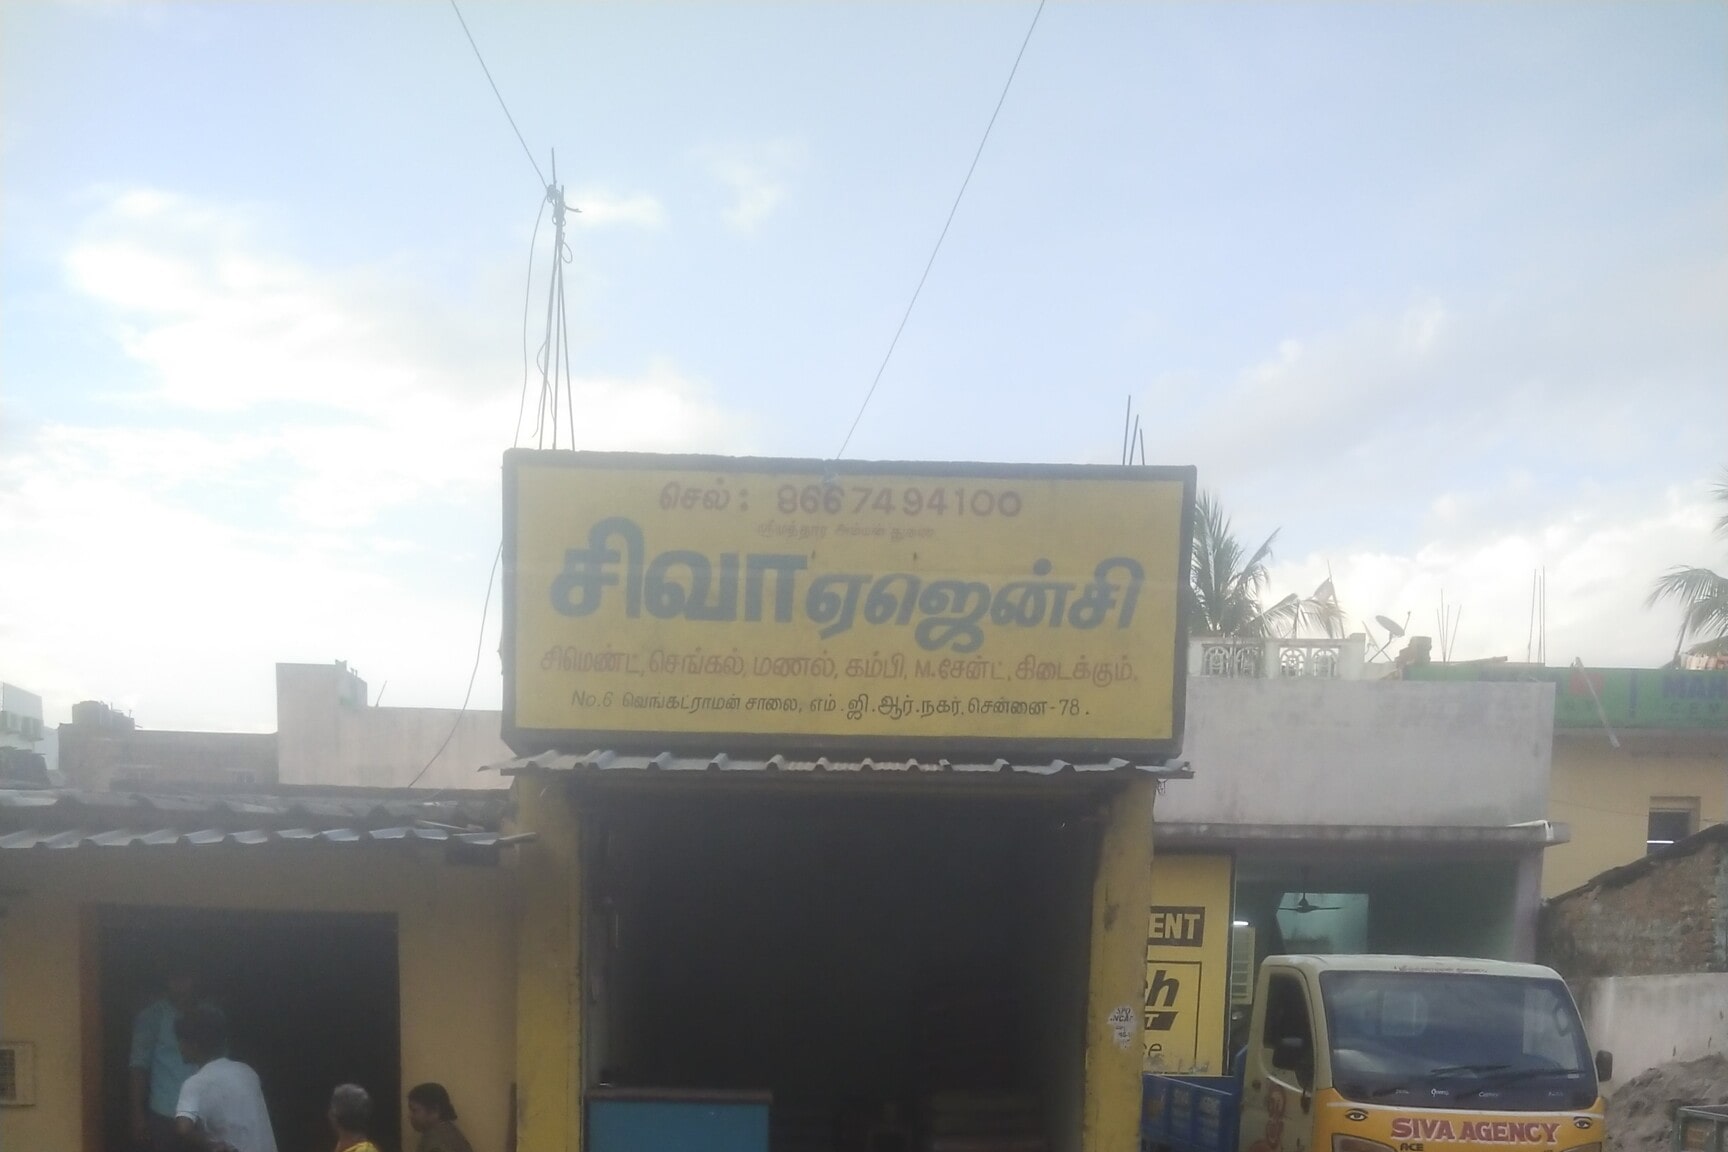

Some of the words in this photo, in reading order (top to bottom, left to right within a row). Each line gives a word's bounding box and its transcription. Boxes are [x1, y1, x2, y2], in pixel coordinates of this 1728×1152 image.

[550, 516, 808, 623] சிவா
[805, 556, 1145, 653] ஏஜென்சி
[1391, 1117, 1456, 1141] SIVA
[1459, 1120, 1561, 1144] AGENCY
[1400, 1143, 1424, 1152] ACE
